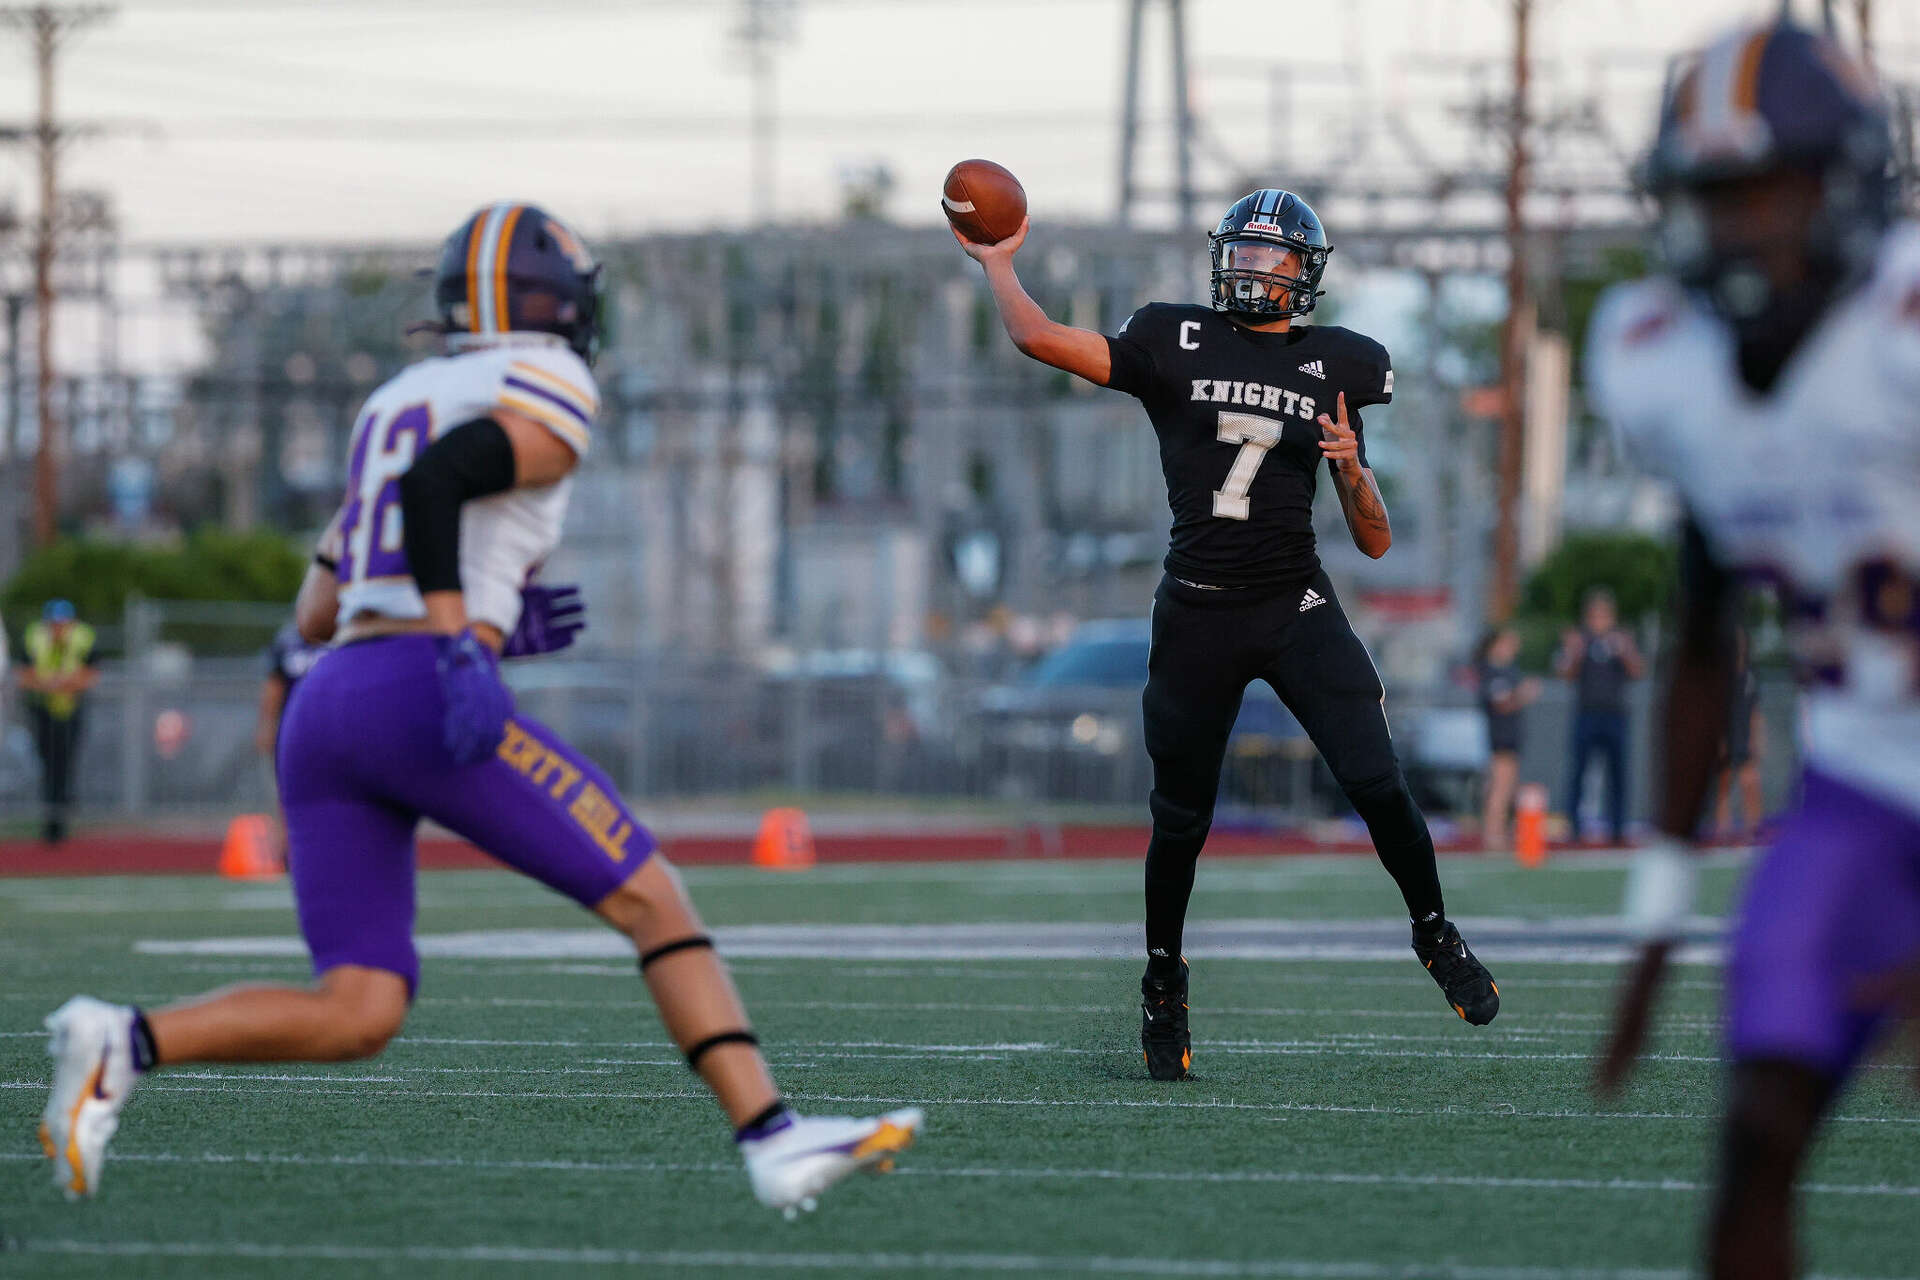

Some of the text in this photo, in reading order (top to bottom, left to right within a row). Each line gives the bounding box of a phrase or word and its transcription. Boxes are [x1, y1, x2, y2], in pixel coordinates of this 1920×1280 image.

[1248, 222, 1279, 232] Riddell
[1179, 320, 1201, 350] C
[1299, 366, 1326, 380] adidas
[1191, 379, 1316, 421] KNIGHTS
[1212, 411, 1284, 520] 7
[1299, 598, 1327, 612] adidas
